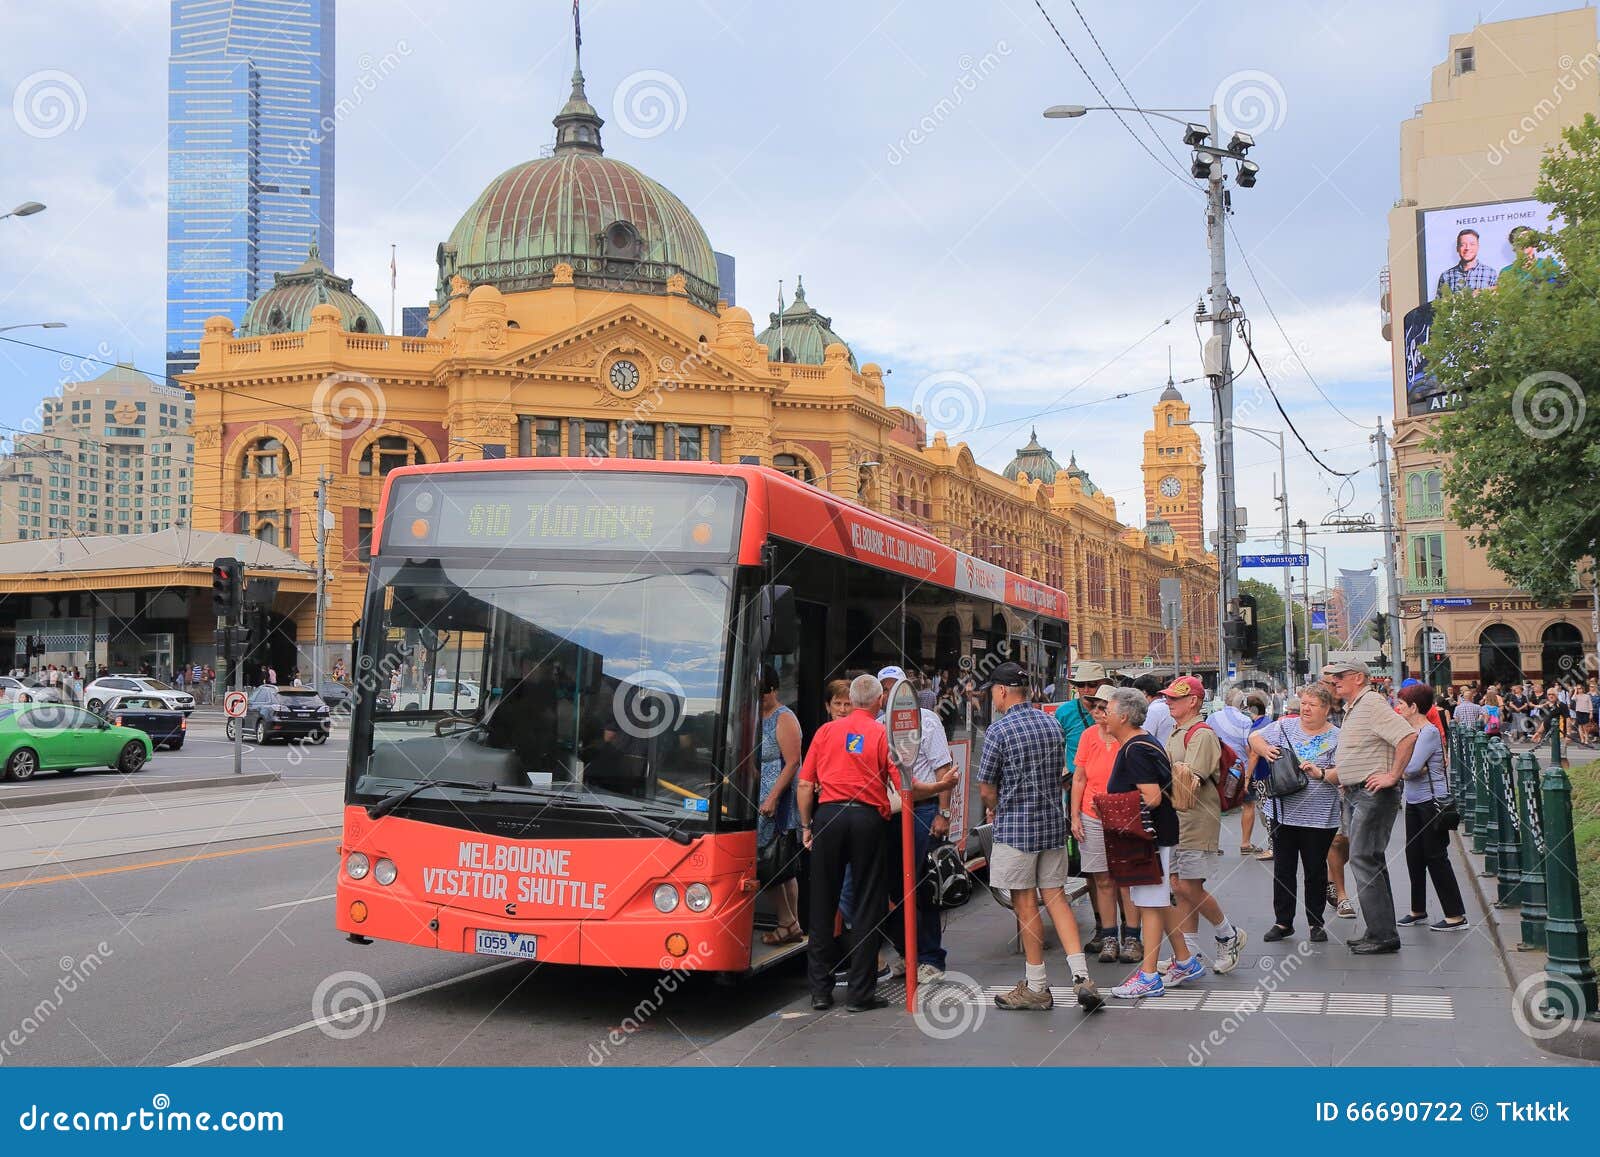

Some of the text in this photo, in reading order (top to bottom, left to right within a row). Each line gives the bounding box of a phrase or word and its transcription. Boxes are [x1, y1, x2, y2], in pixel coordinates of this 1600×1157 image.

[1456, 217, 1477, 225] NEED
[1487, 214, 1505, 222] LIFT
[1507, 211, 1536, 221] HOME?
[467, 503, 654, 539] $10 TWO DAYS
[1260, 554, 1307, 564] Swanston St
[458, 842, 571, 876] MELBOURNE
[423, 868, 607, 910] VISITOR SHUTTLE
[479, 935, 507, 950] 1059
